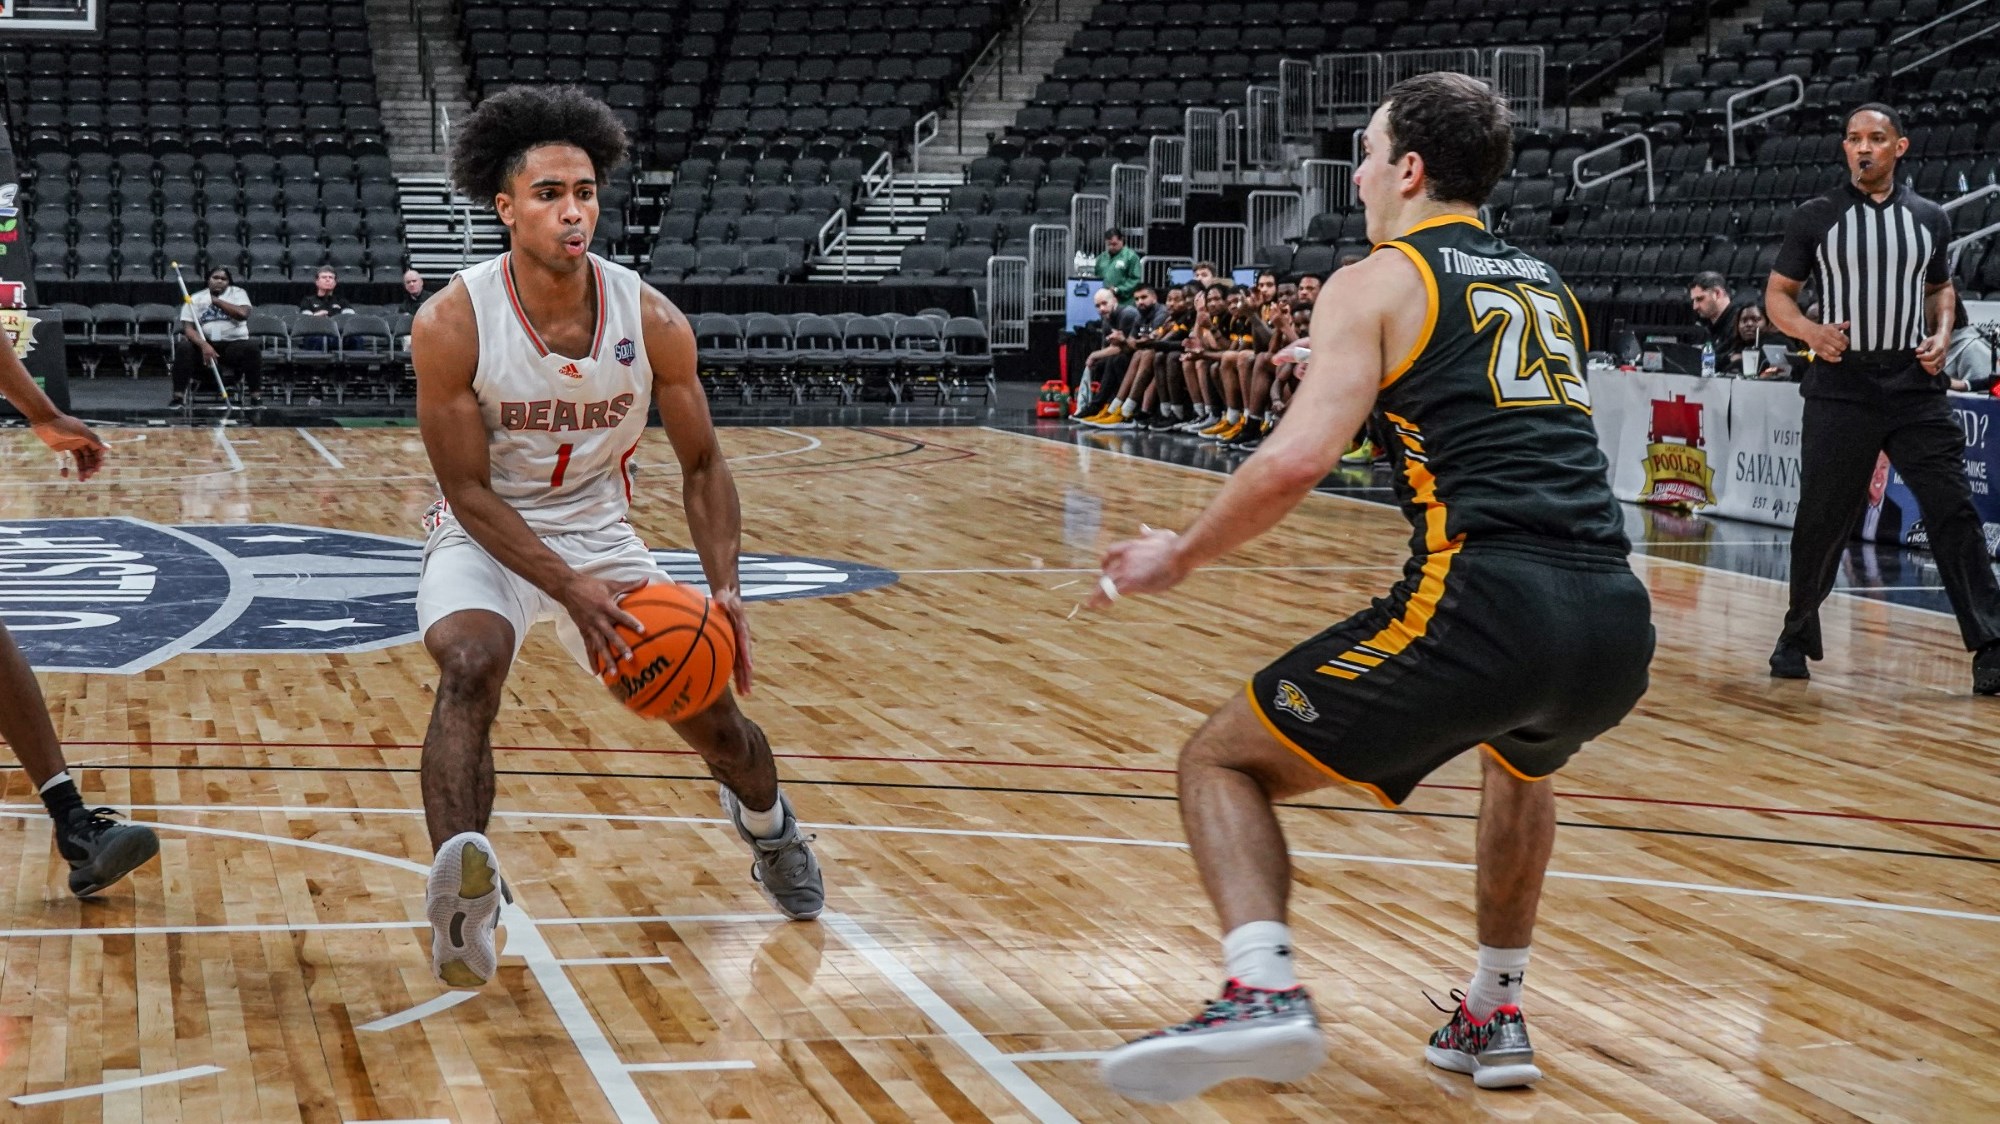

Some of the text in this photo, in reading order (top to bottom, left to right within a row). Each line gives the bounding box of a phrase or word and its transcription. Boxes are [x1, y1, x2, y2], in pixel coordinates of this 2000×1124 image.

[1438, 247, 1550, 283] TIMBERLAKE
[1466, 282, 1592, 415] 25
[558, 368, 583, 379] adidas
[500, 393, 634, 432] BEARS
[1773, 429, 1800, 446] VISIT
[551, 443, 574, 487] 1
[1652, 453, 1702, 479] POOLER
[1736, 451, 1801, 488] SAVANN
[620, 655, 671, 697] lson
